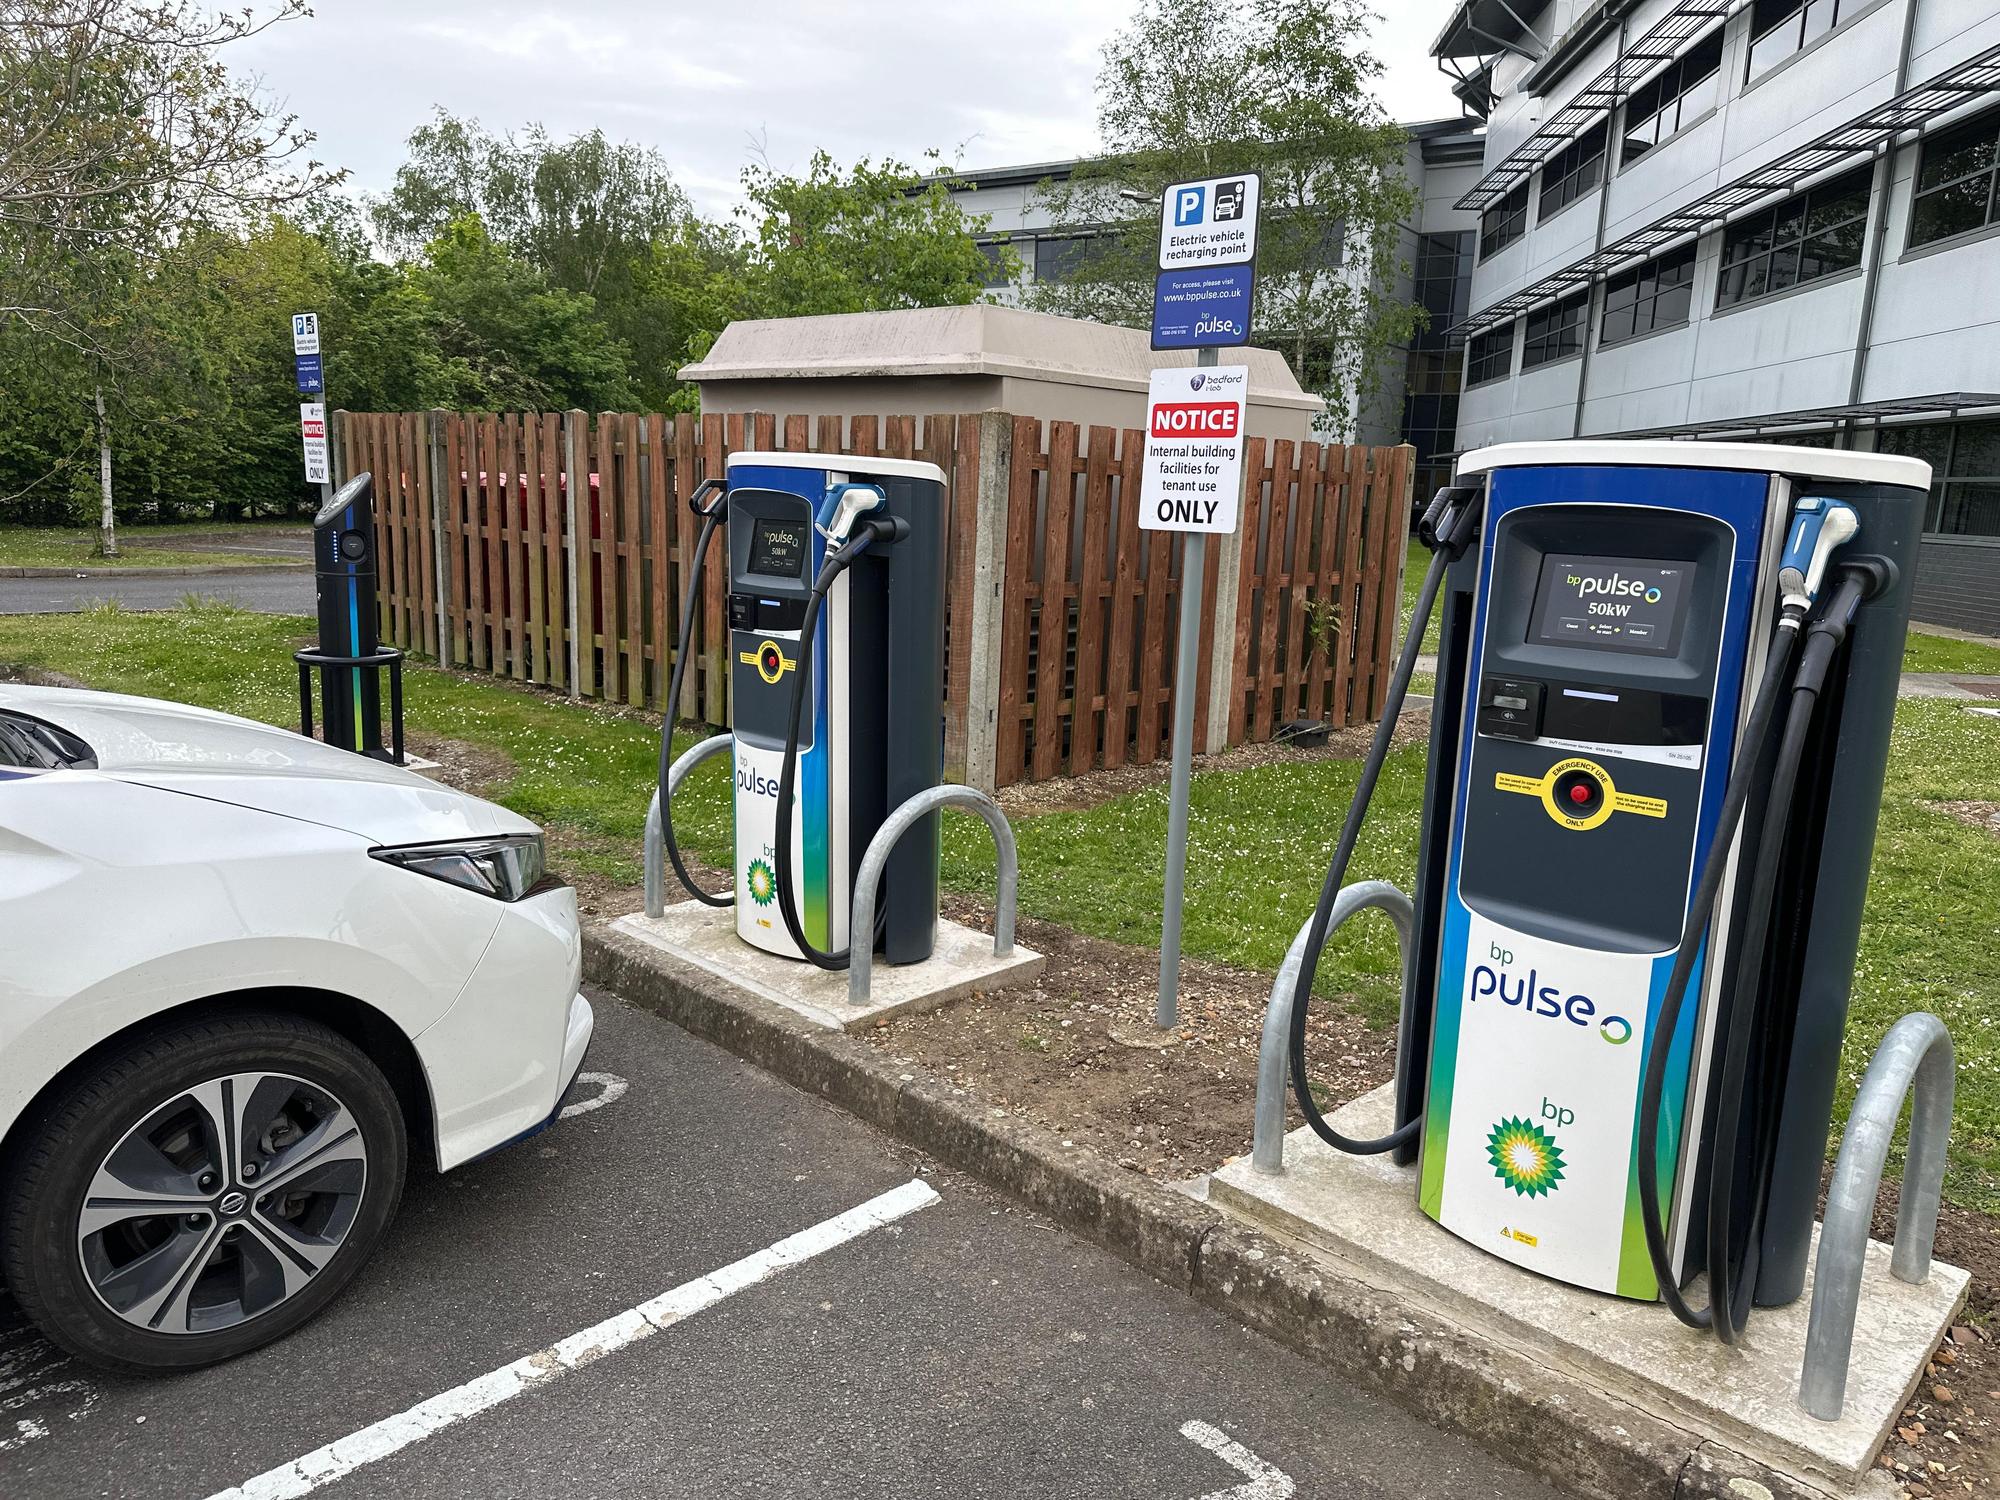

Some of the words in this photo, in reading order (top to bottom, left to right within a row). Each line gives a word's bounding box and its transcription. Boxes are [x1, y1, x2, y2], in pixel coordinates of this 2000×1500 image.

[1170, 234, 1206, 246] Electric
[1210, 230, 1245, 242] vehicle
[1166, 246, 1217, 260] recharging
[1220, 242, 1246, 256] point
[1203, 280, 1220, 288] please
[1164, 288, 1241, 302] www.bppulse.co.uk
[1195, 316, 1232, 338] pulse
[1207, 374, 1242, 384] bedford
[1155, 409, 1235, 430] NOTICE
[304, 424, 323, 434] NOTICE
[1150, 445, 1189, 457] Internal
[1192, 445, 1235, 460] building
[310, 467, 324, 479] ONLY
[1160, 462, 1202, 474] facilities
[1204, 462, 1220, 474] for
[1162, 480, 1196, 491] tenant
[1198, 483, 1216, 491] use
[1157, 499, 1218, 524] ONLY
[768, 530, 792, 545] pulse
[1566, 574, 1581, 586] bp
[1578, 573, 1645, 598] pulse
[1588, 602, 1631, 617] 50kW
[739, 756, 748, 766] bp
[1552, 762, 1596, 776] EMERGENCY
[1595, 770, 1608, 783] USE
[736, 767, 778, 798] pulse
[1490, 940, 1514, 967] bp
[1471, 965, 1596, 1026] pulse
[1541, 1096, 1574, 1127] bp
